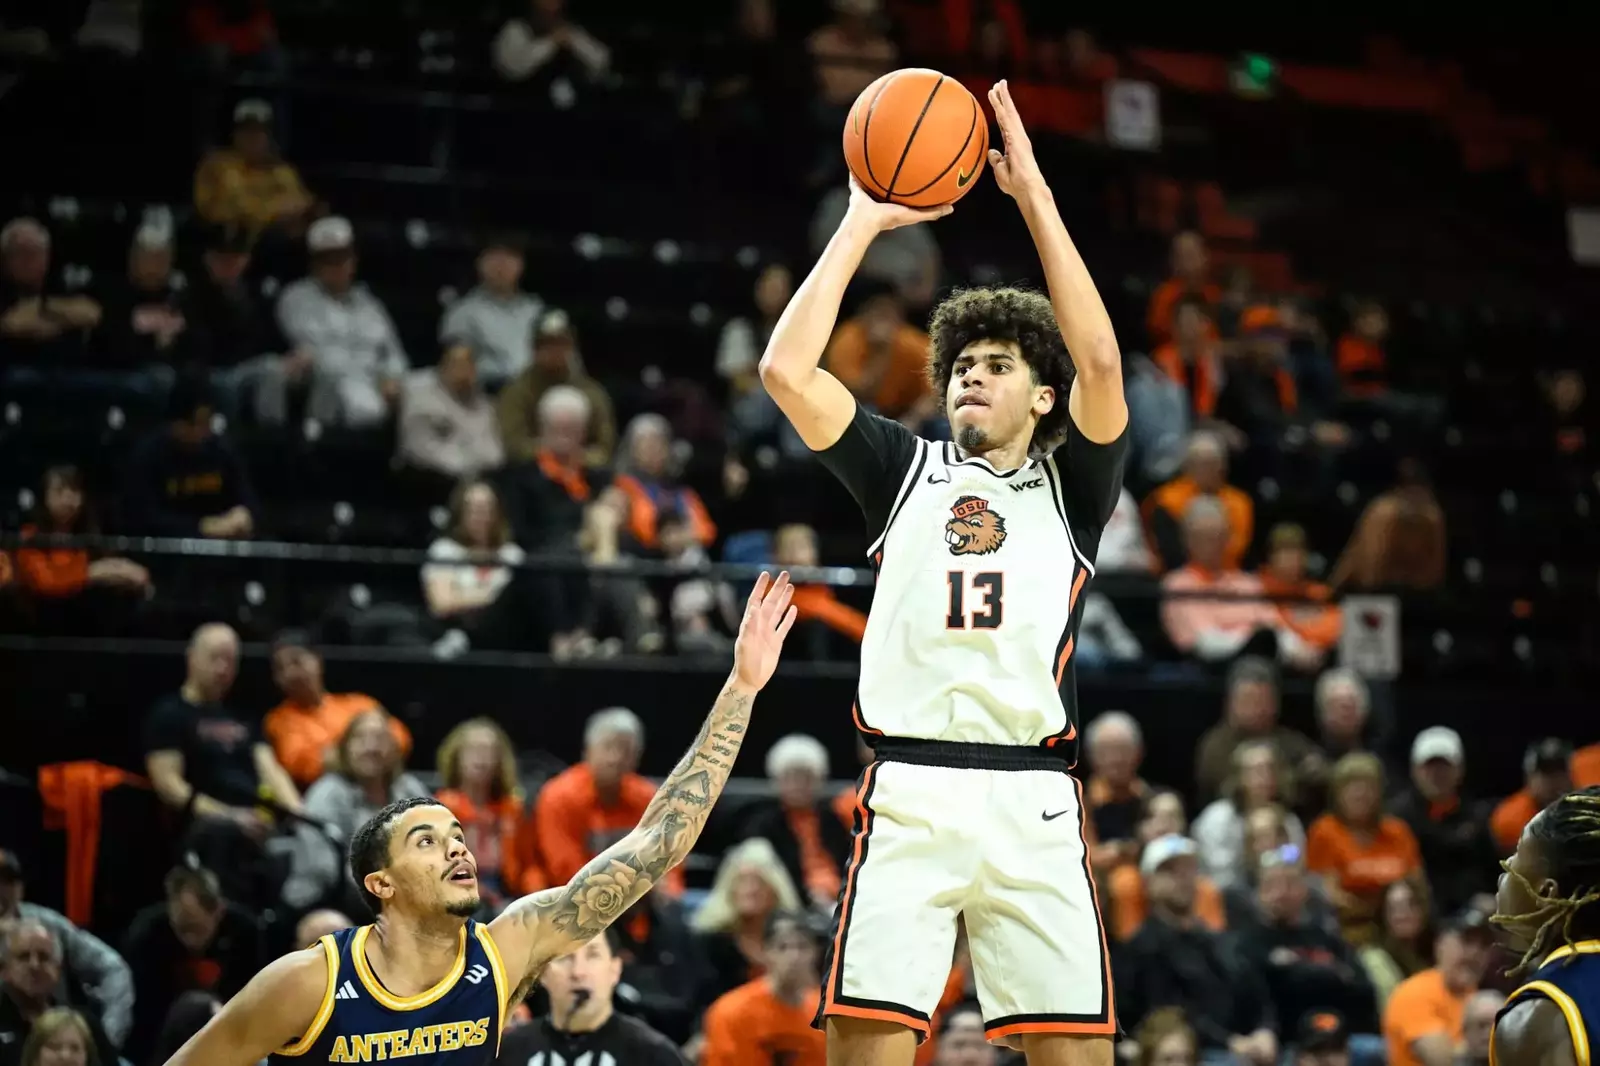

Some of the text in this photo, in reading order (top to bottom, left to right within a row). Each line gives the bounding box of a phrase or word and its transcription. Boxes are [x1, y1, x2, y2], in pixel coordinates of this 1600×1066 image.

[1009, 478, 1044, 492] WCC
[956, 501, 986, 516] OSU
[945, 570, 1004, 630] 13
[328, 1017, 491, 1063] ANTEATERS
